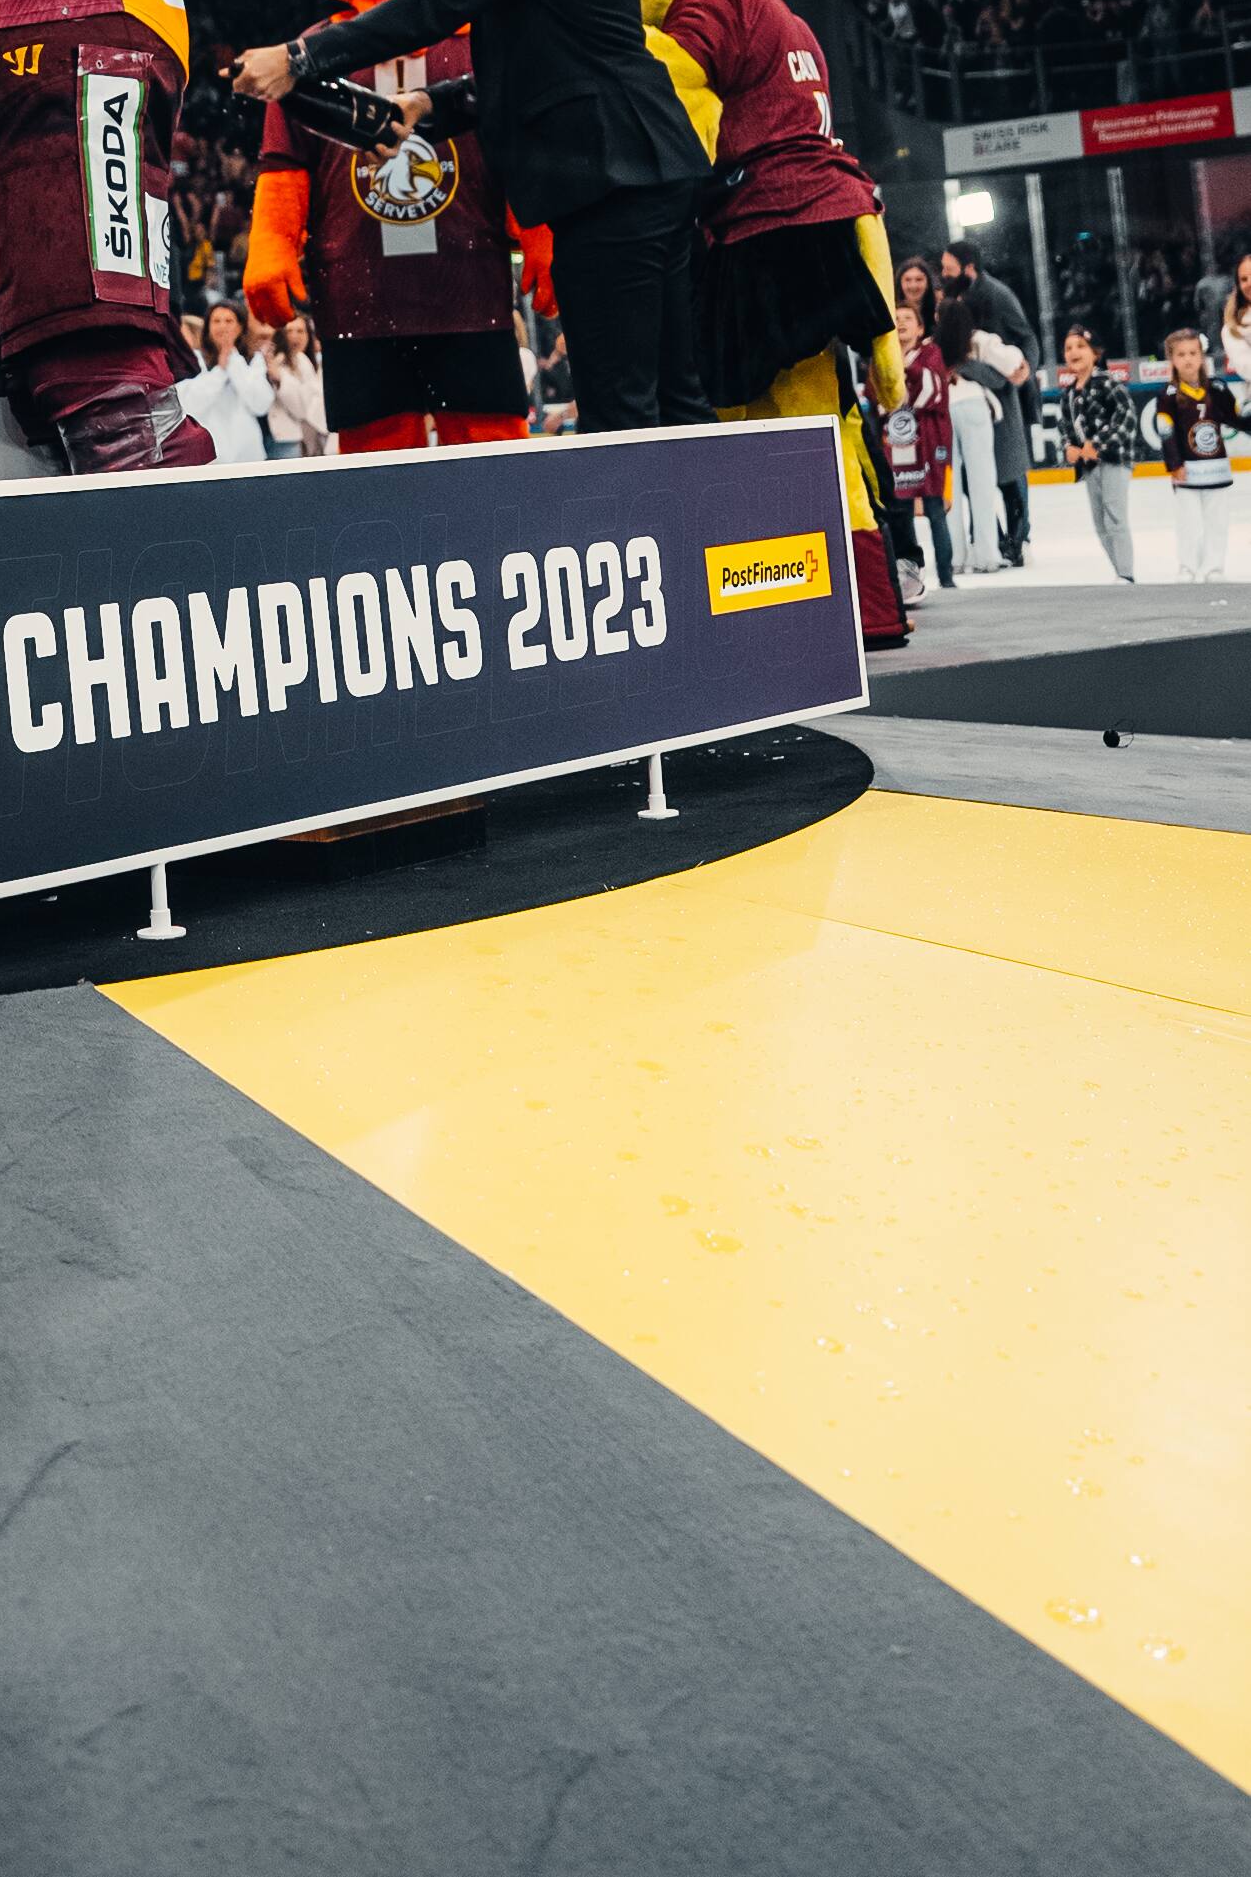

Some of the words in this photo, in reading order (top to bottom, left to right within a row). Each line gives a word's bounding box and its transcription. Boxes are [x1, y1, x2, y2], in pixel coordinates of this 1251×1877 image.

[102, 91, 132, 260] ŠKODA
[364, 188, 448, 219] SERVETTE
[721, 562, 805, 591] PostFinance
[3, 559, 483, 753] CHAMPIONS
[501, 535, 667, 671] 2023
